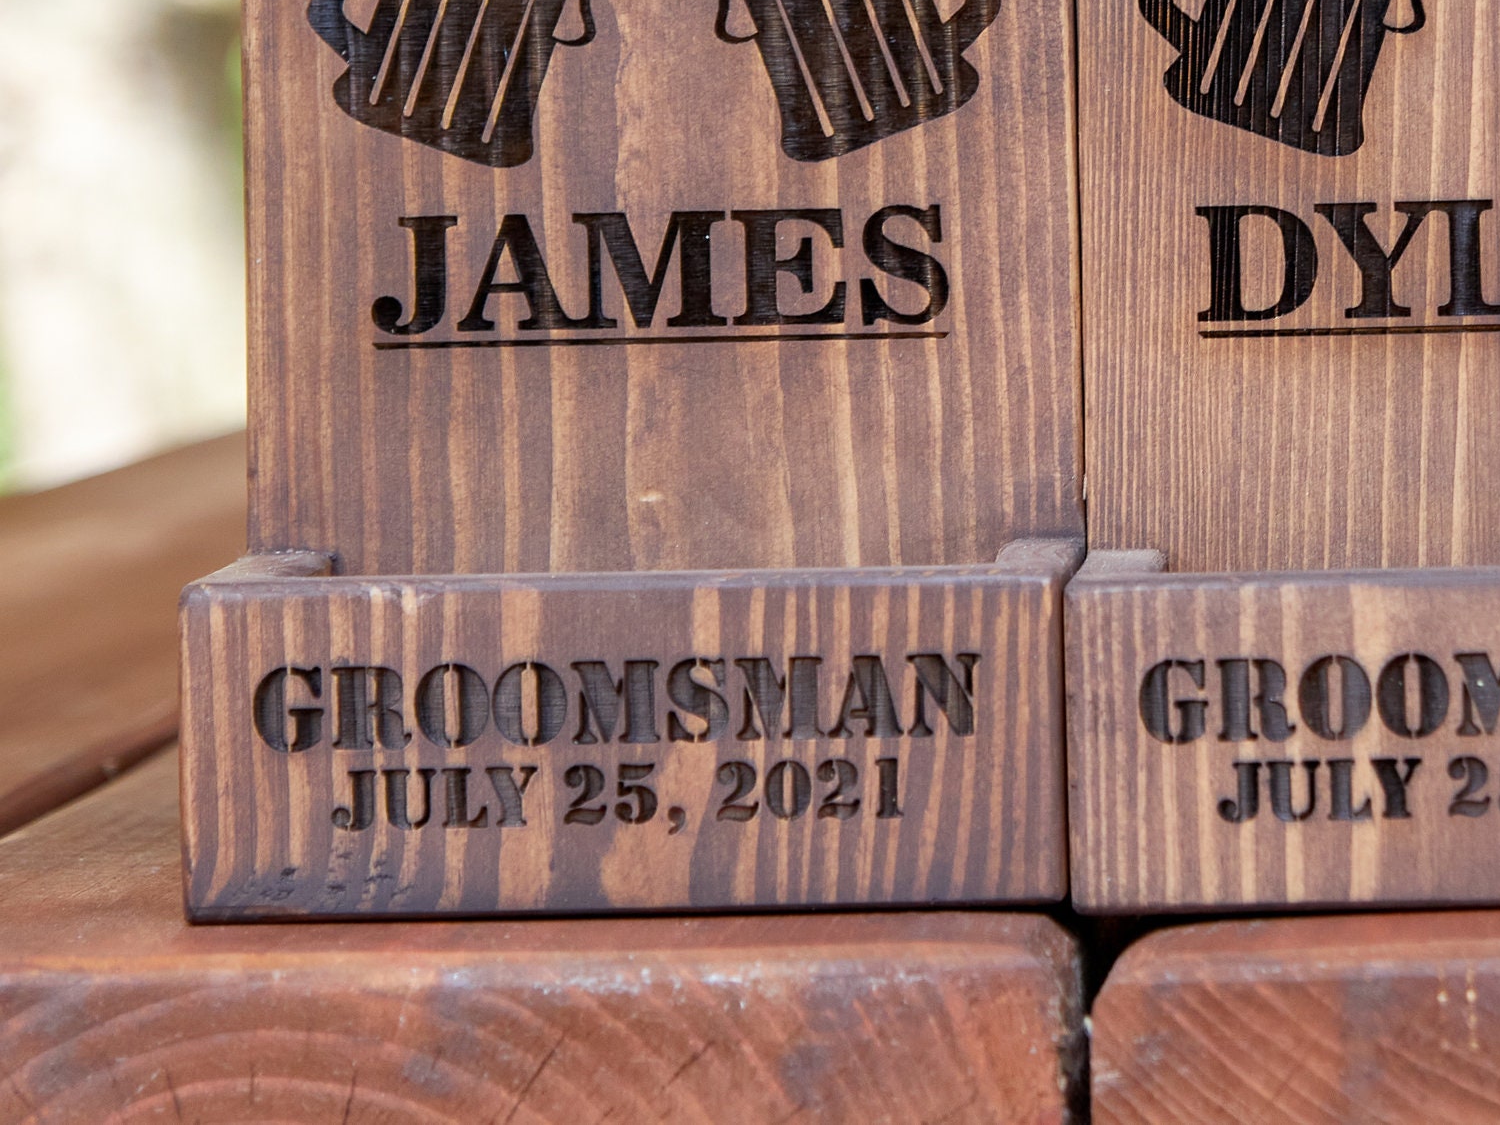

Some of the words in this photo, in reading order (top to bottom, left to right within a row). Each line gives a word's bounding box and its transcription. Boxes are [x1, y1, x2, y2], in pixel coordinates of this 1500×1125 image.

[371, 204, 949, 334] JAMES
[253, 652, 982, 753] GROOMSMAN
[331, 766, 538, 832] JULY
[564, 759, 687, 835] 25,
[716, 757, 904, 822] 2021
[1217, 757, 1421, 824] JULY
